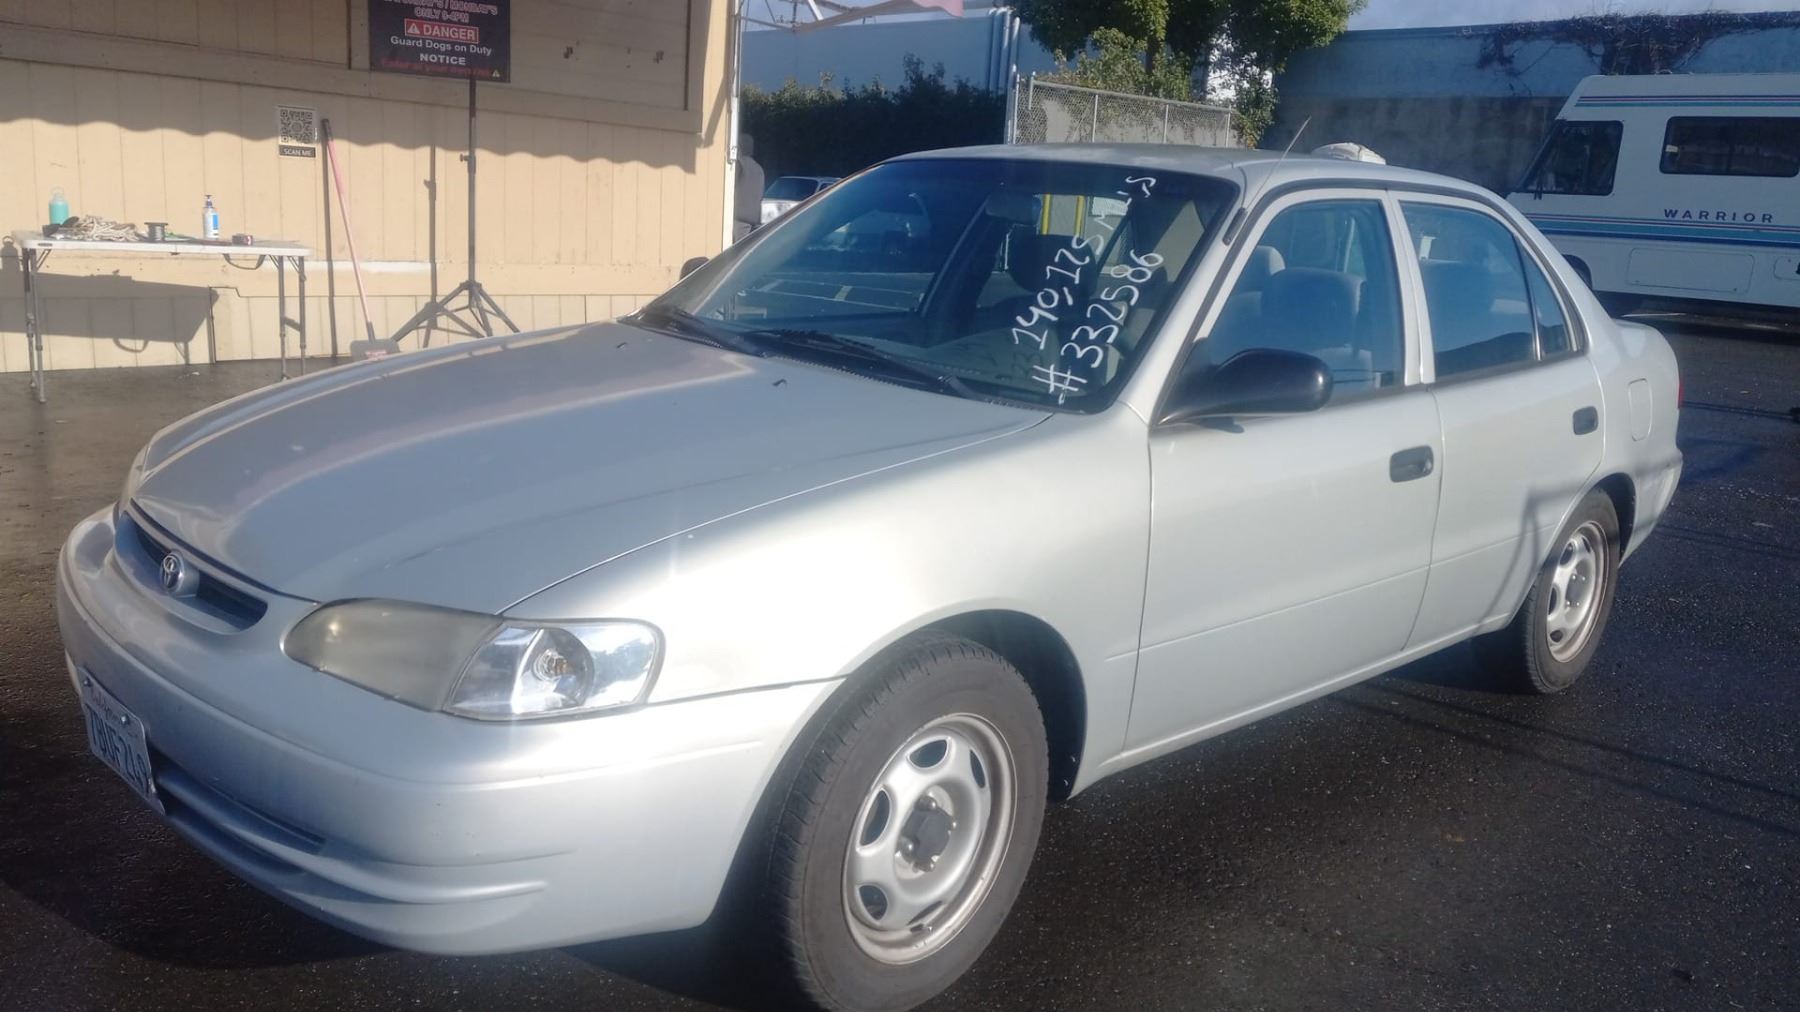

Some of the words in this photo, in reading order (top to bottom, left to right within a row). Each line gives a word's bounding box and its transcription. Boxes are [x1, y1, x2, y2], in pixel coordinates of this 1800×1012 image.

[414, 7, 440, 19] ONLY
[423, 24, 475, 41] DANGER
[390, 35, 423, 48] Guard
[425, 40, 452, 53] Dogs
[454, 44, 467, 53] on
[469, 45, 492, 56] Duty
[420, 53, 467, 66] NOTICE
[1664, 208, 1773, 223] WARRIOR
